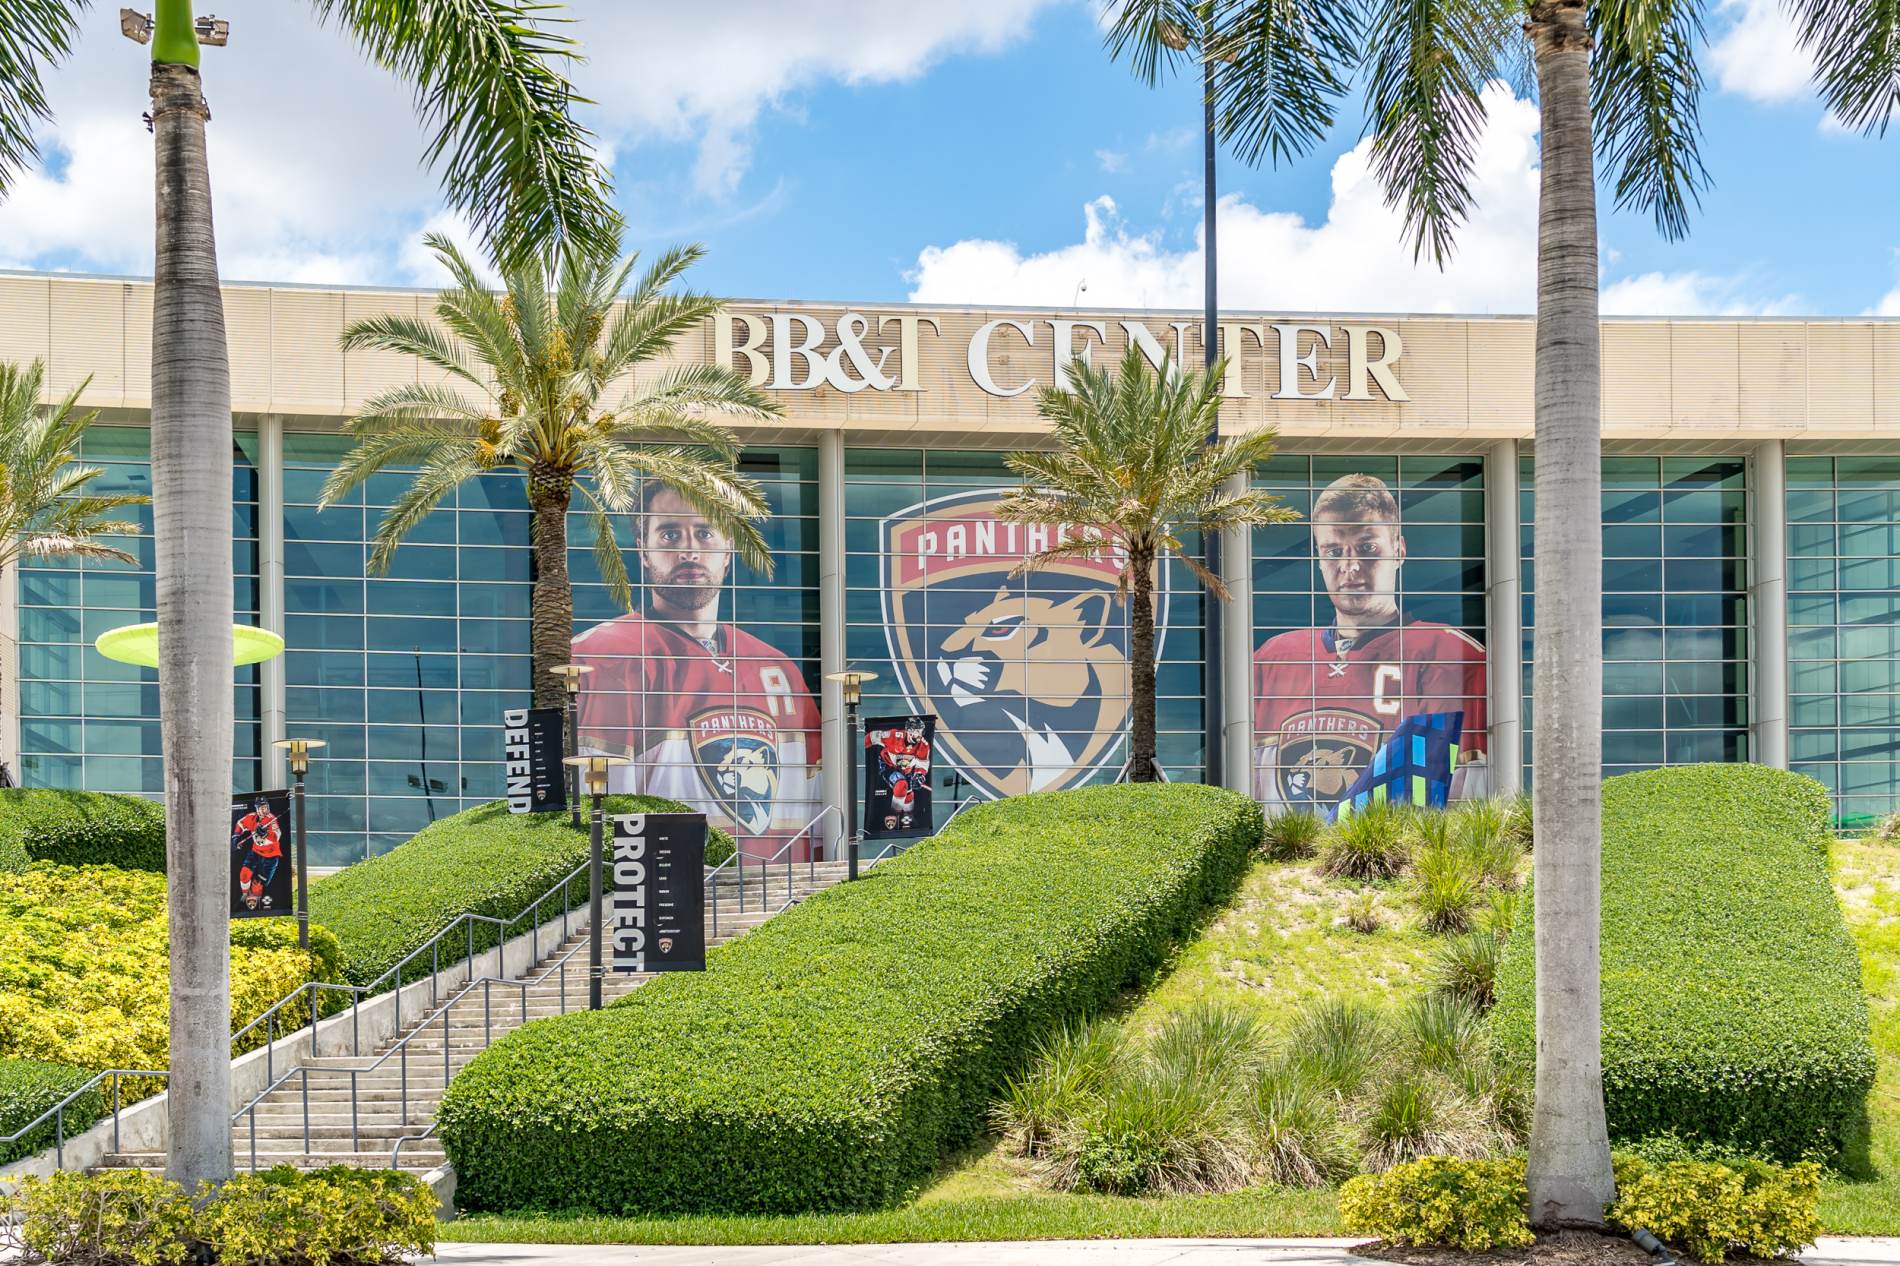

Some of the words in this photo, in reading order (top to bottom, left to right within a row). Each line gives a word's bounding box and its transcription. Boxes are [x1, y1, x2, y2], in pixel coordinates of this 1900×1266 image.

[705, 308, 941, 393] BB&T
[966, 317, 1411, 402] CENTER
[504, 709, 532, 814] DEFEND
[700, 715, 774, 741] PANTHERS
[1286, 717, 1369, 740] PANTHERS
[613, 813, 646, 972] PROTECT
